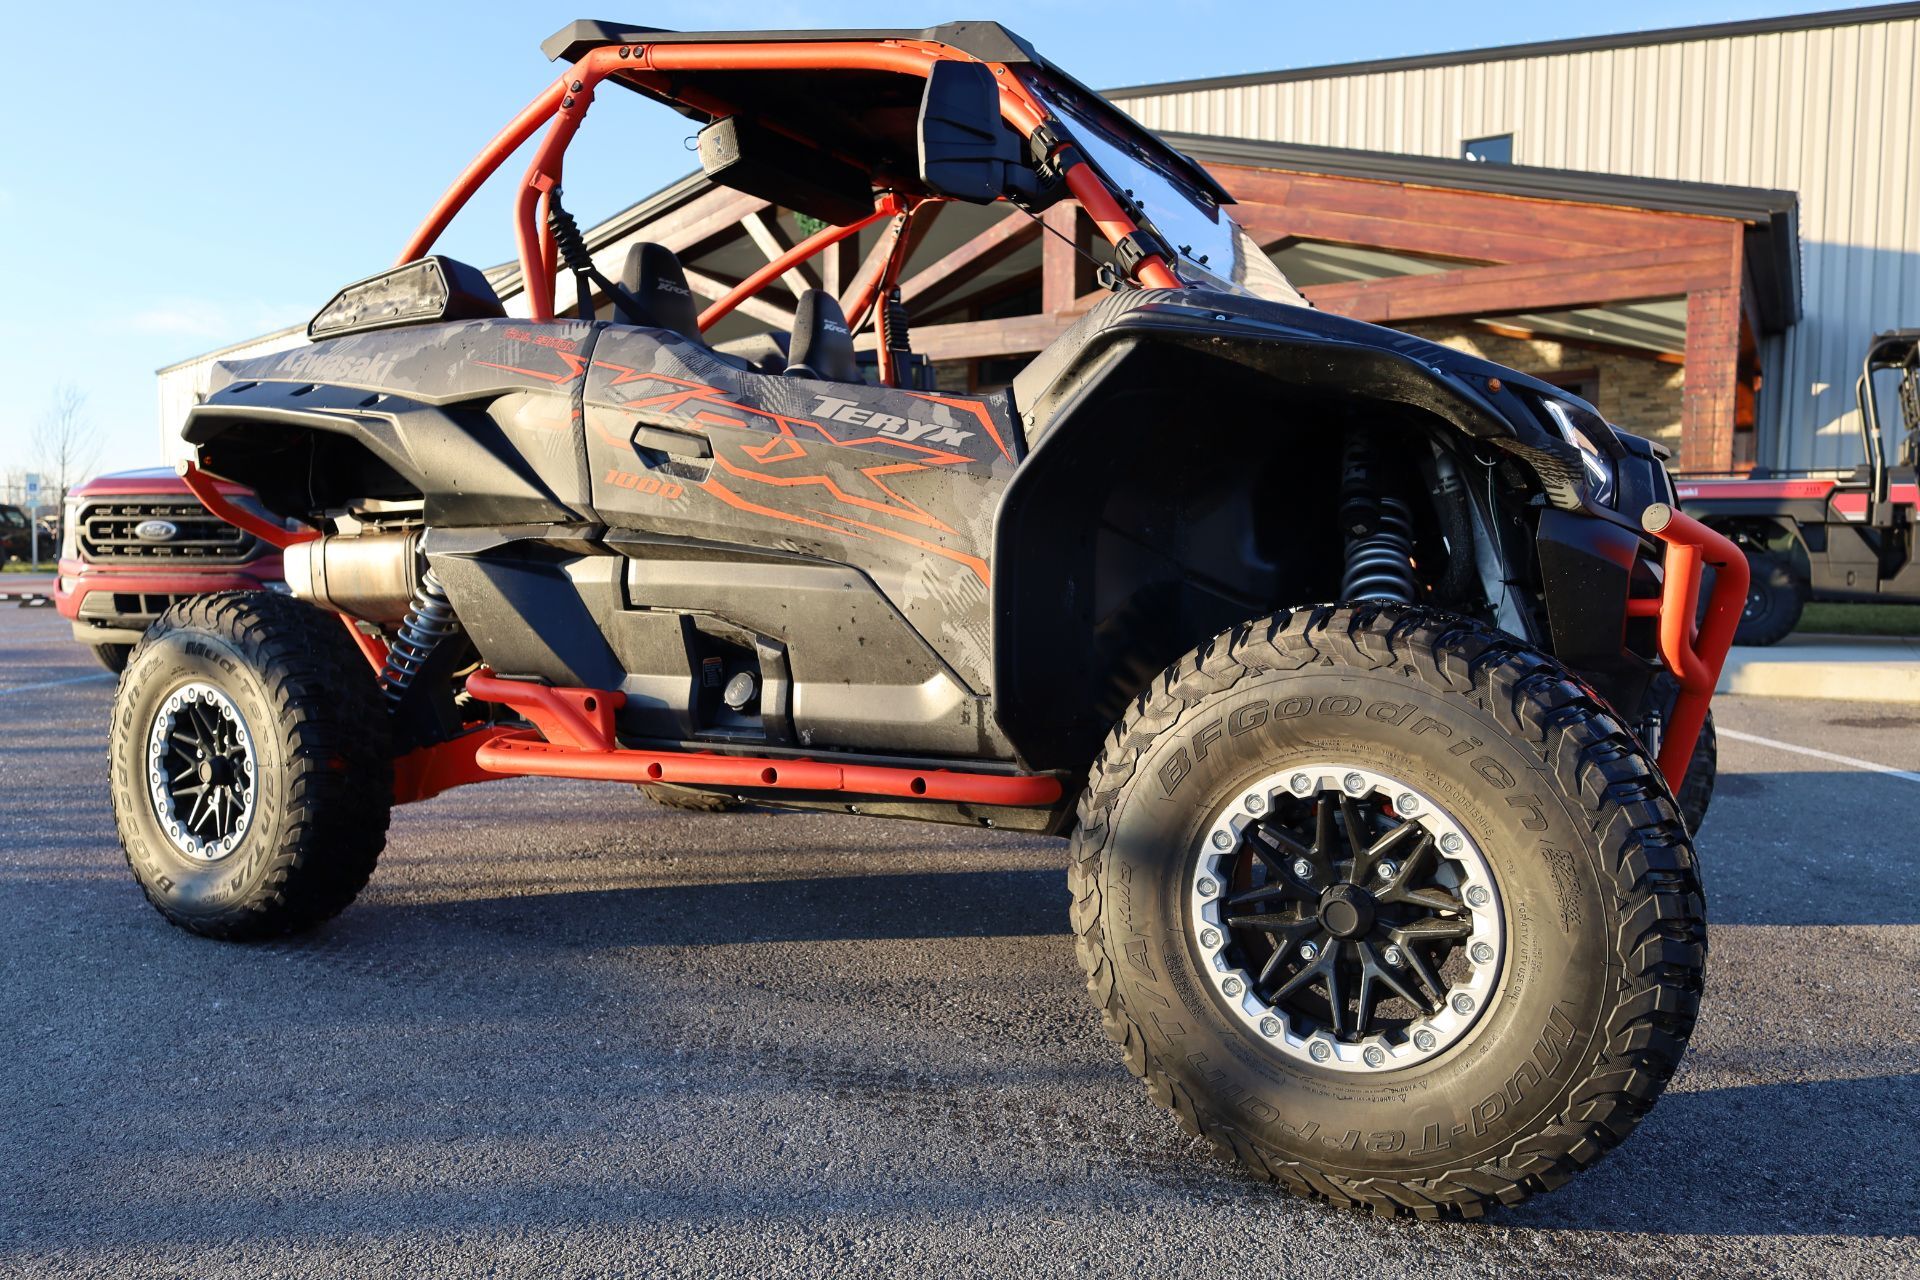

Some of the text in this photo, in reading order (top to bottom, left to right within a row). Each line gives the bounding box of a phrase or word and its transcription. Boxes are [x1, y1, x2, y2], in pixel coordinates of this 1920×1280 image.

[532, 334, 578, 352] EDITION
[275, 351, 398, 382] Kawasaki
[604, 469, 684, 499] 1000
[1157, 693, 1548, 832] BFGoodrich
[1520, 919, 1529, 942] ATV
[1519, 948, 1528, 965] UTV
[1517, 965, 1527, 986] USE
